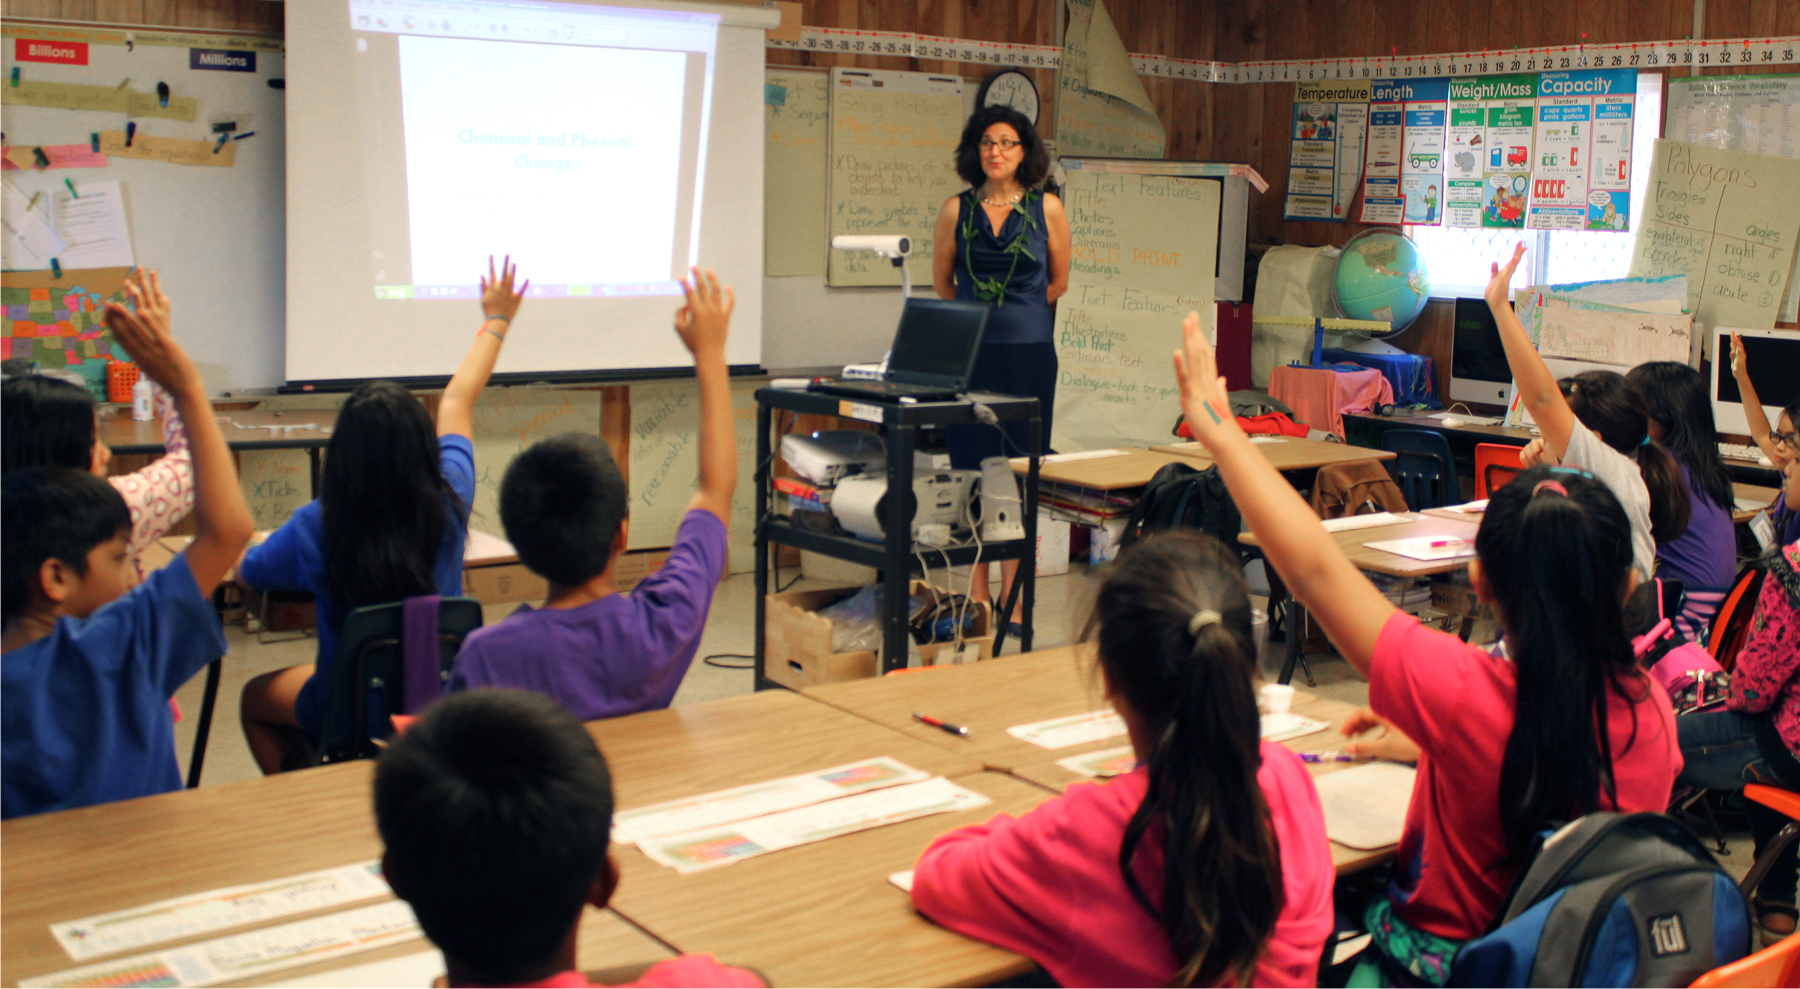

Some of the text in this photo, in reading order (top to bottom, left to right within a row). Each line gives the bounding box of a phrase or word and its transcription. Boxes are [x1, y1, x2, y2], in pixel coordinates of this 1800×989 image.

[29, 44, 76, 59] Billions
[200, 53, 247, 67] Millions
[804, 38, 816, 48] -30
[820, 39, 833, 49] -29
[837, 40, 849, 50] -28
[852, 41, 864, 50] -27
[868, 42, 880, 51] -26
[884, 43, 896, 52] -25
[899, 44, 911, 53] -24
[916, 46, 927, 56] -23
[930, 48, 942, 56] -22
[945, 49, 956, 58] -21
[960, 50, 972, 60] -20
[975, 52, 986, 61] -19
[990, 53, 1000, 62] -18
[1004, 54, 1016, 62] -17
[1018, 55, 1029, 64] -16
[1032, 56, 1044, 66] -15
[1048, 57, 1060, 66] -14
[1362, 68, 1370, 77] 10
[1376, 68, 1382, 76] 11
[1390, 67, 1396, 76] 12
[1404, 67, 1412, 76] 13
[1419, 66, 1426, 75] 14
[1434, 65, 1441, 74] 15
[1448, 65, 1456, 74] 16
[1464, 64, 1472, 73] 17
[1480, 63, 1487, 72] 18
[1496, 62, 1504, 71] 19
[1511, 62, 1520, 70] 20
[1528, 60, 1535, 70] 21
[1544, 59, 1552, 68] 22
[1561, 58, 1570, 68] 23
[1578, 58, 1586, 67] 24
[1594, 57, 1603, 66] 25
[1612, 56, 1622, 65] 26
[1630, 55, 1640, 64] 27
[1648, 54, 1658, 64] 28
[1666, 54, 1676, 63] 29
[1684, 53, 1692, 63] 30
[1699, 53, 1709, 63] 31
[1720, 52, 1730, 62] 32
[1740, 52, 1752, 62] 33
[1761, 51, 1772, 61] 34
[1782, 50, 1794, 60] 35
[1298, 87, 1368, 100] Temperature
[1371, 85, 1414, 102] Length
[1451, 83, 1532, 100] Weight/Mass
[1541, 77, 1612, 94] Capacity
[1750, 82, 1787, 90] Vocabulary
[459, 129, 633, 152] Chemical and Physical
[514, 154, 581, 173] Changes
[1666, 142, 1756, 192] Polygons
[1092, 172, 1124, 195] Text
[1140, 174, 1201, 200] Features
[1654, 180, 1706, 207] Triangles
[1072, 208, 1114, 224] Photos
[1656, 205, 1690, 226] Sides
[1070, 220, 1116, 237] Captions
[1746, 221, 1780, 245] angles
[1070, 234, 1120, 250] Diagrams
[1070, 246, 1182, 267] BOLD PRINT
[1726, 242, 1758, 264] right
[1070, 258, 1121, 280] Headings
[1718, 260, 1760, 283] obtuse
[1079, 284, 1180, 314] Text Features
[1713, 284, 1748, 302] acute
[1063, 321, 1127, 341] Illustrations
[1061, 332, 1114, 352] Bold Print
[1120, 352, 1143, 368] text
[641, 431, 690, 507] reasonable
